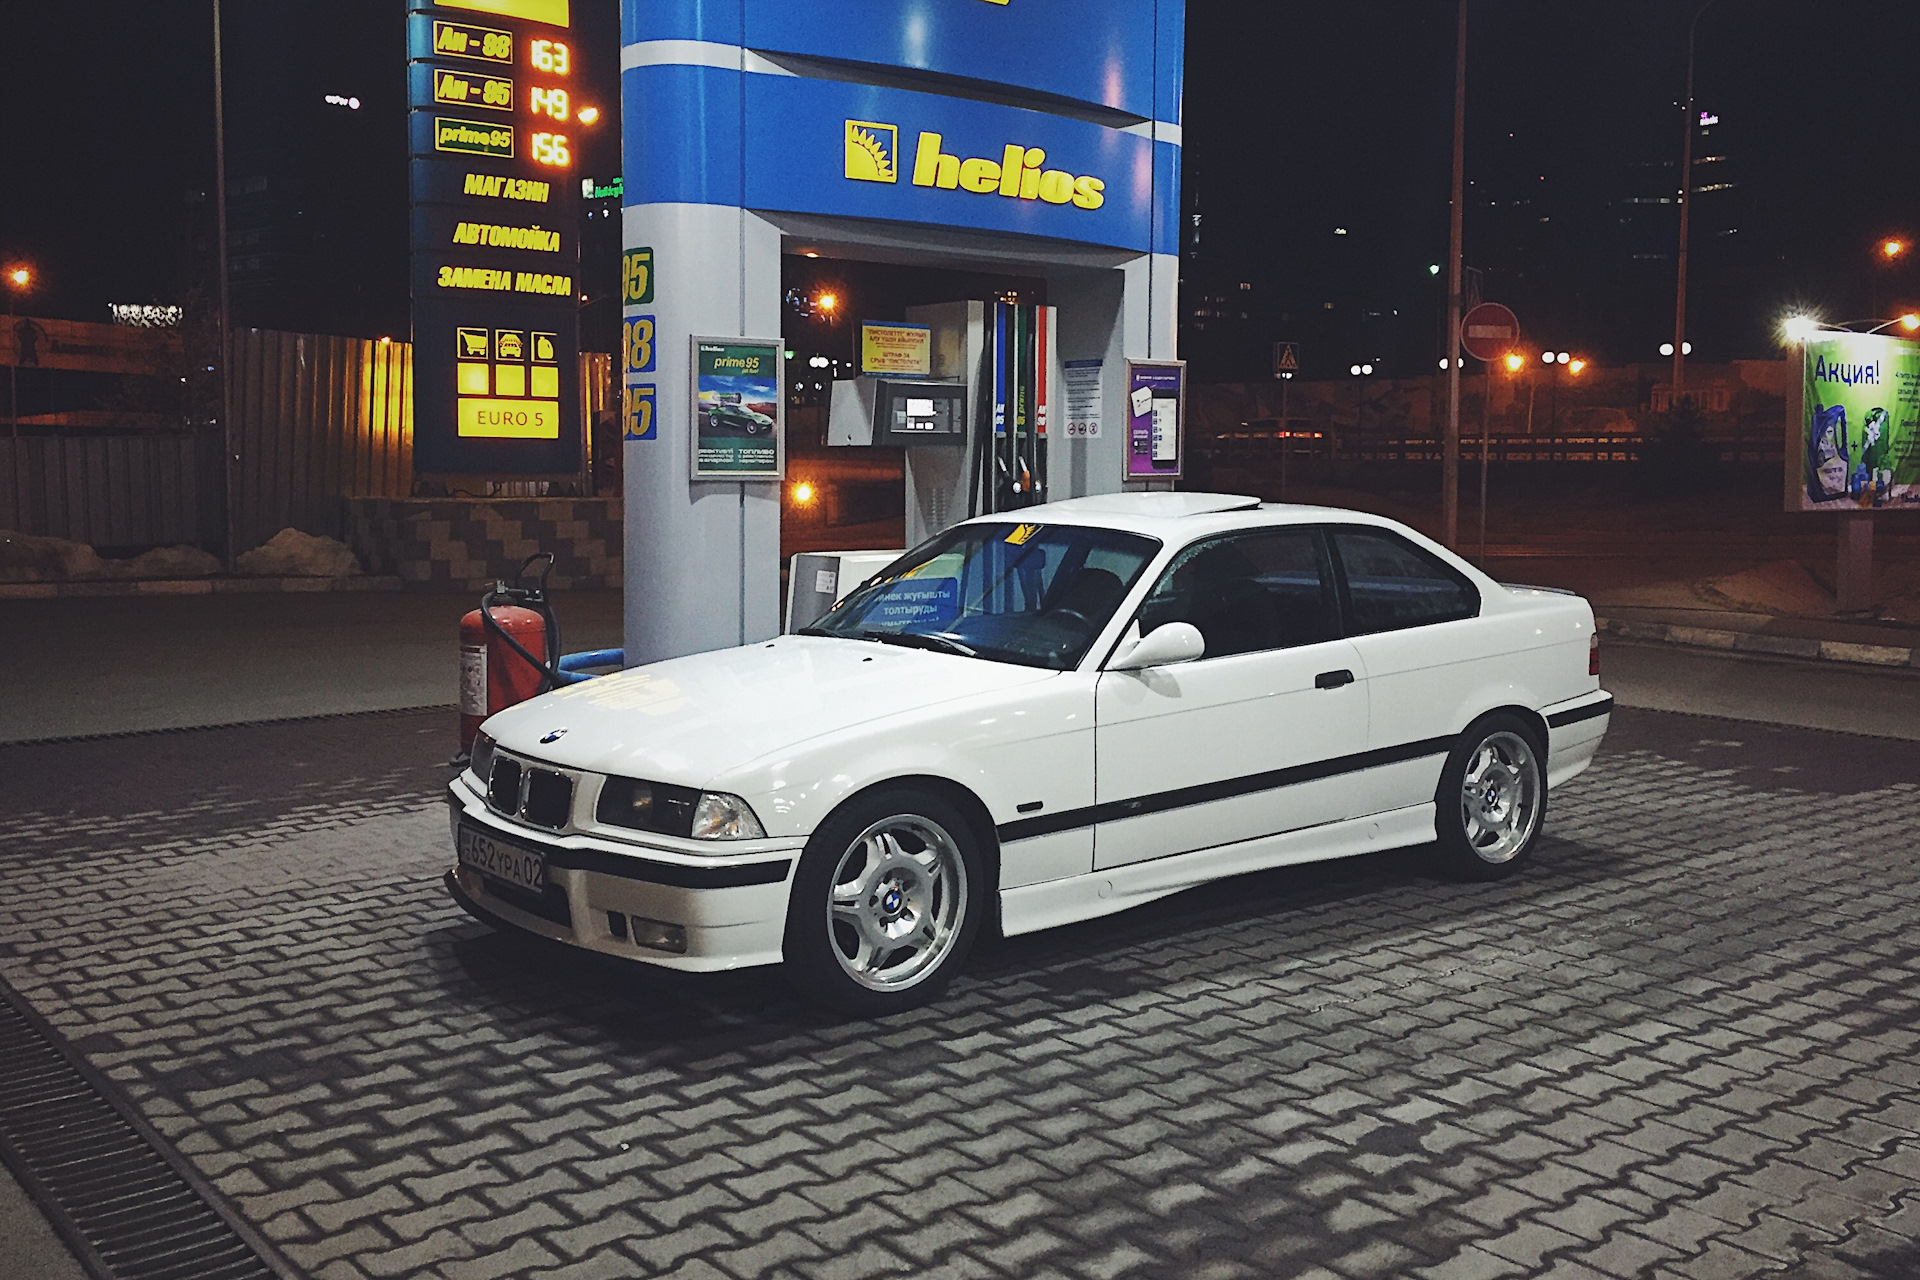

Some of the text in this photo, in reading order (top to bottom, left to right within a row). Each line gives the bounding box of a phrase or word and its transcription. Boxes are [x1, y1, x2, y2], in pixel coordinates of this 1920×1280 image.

[531, 40, 569, 74] 163
[530, 87, 568, 120] 149
[531, 133, 569, 165] 156
[912, 131, 1105, 209] helios
[464, 173, 550, 203] МАГАЗИН
[453, 222, 560, 252] АВТОМОЙКА
[438, 266, 571, 296] ЗАМЕНА МАСЛА
[1815, 354, 1879, 387] Акция!
[477, 410, 544, 427] EURO 5
[884, 605, 938, 616] толтыруды
